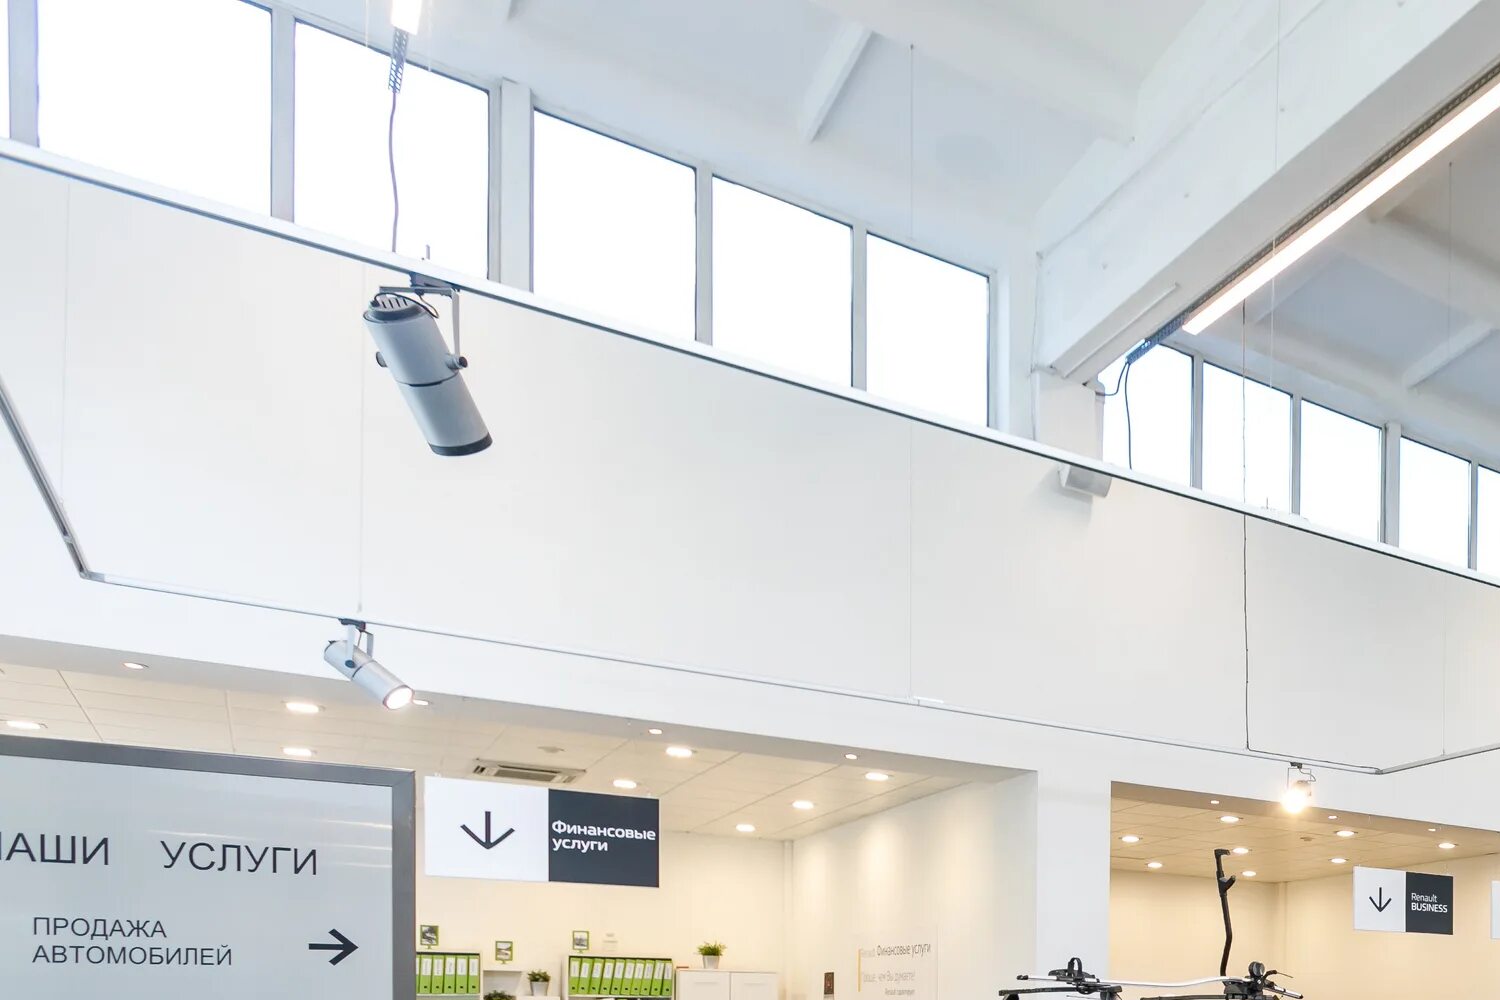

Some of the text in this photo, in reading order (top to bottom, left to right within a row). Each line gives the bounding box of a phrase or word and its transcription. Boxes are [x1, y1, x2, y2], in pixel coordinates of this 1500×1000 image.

[551, 819, 656, 841] Финансовые
[0, 832, 318, 876] АШИ УСЛУГИ
[552, 836, 609, 854] услуги
[1411, 892, 1438, 903] Renault
[1411, 902, 1448, 913] BUSINESS
[32, 916, 168, 941] ПРОДАЖА
[31, 944, 233, 966] АВТОМОБИЛЕЙ
[876, 945, 911, 956] Финансовые
[911, 944, 931, 958] услуги
